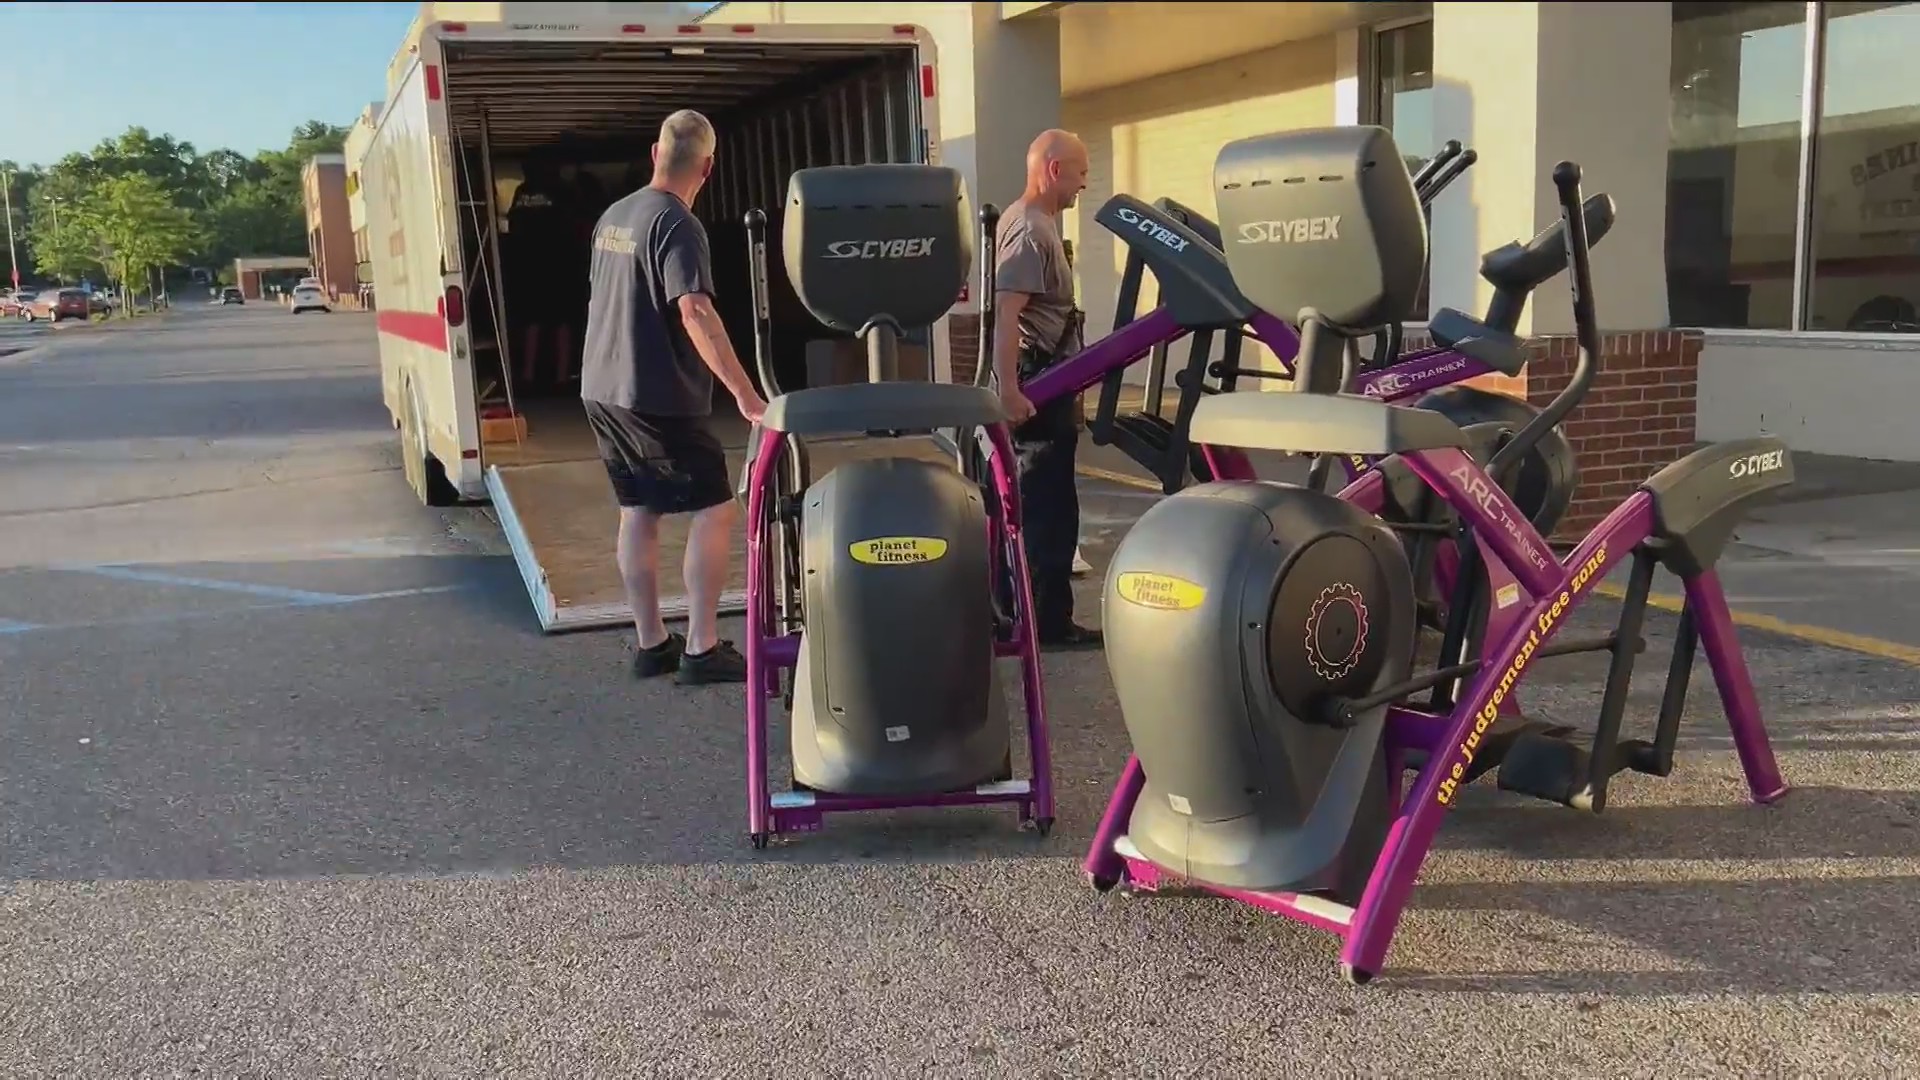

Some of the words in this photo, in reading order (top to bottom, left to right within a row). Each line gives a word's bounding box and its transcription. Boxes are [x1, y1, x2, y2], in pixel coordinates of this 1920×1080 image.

[1138, 218, 1189, 252] CYBEX
[1267, 215, 1341, 242] CYBEX
[860, 237, 936, 259] CYBEX
[1363, 372, 1410, 397] ARC
[1409, 358, 1466, 382] TRAINER
[1747, 449, 1783, 475] CYBEX
[1449, 466, 1504, 520] ARC
[1500, 510, 1548, 572] TRAINER
[869, 540, 918, 554] planet
[877, 551, 929, 562] fitness
[1132, 576, 1174, 593] planet
[1136, 588, 1181, 607] fitness
[1437, 762, 1464, 804] the
[1460, 630, 1540, 764] judgement
[1538, 591, 1570, 636] free
[1571, 548, 1606, 594] zone
